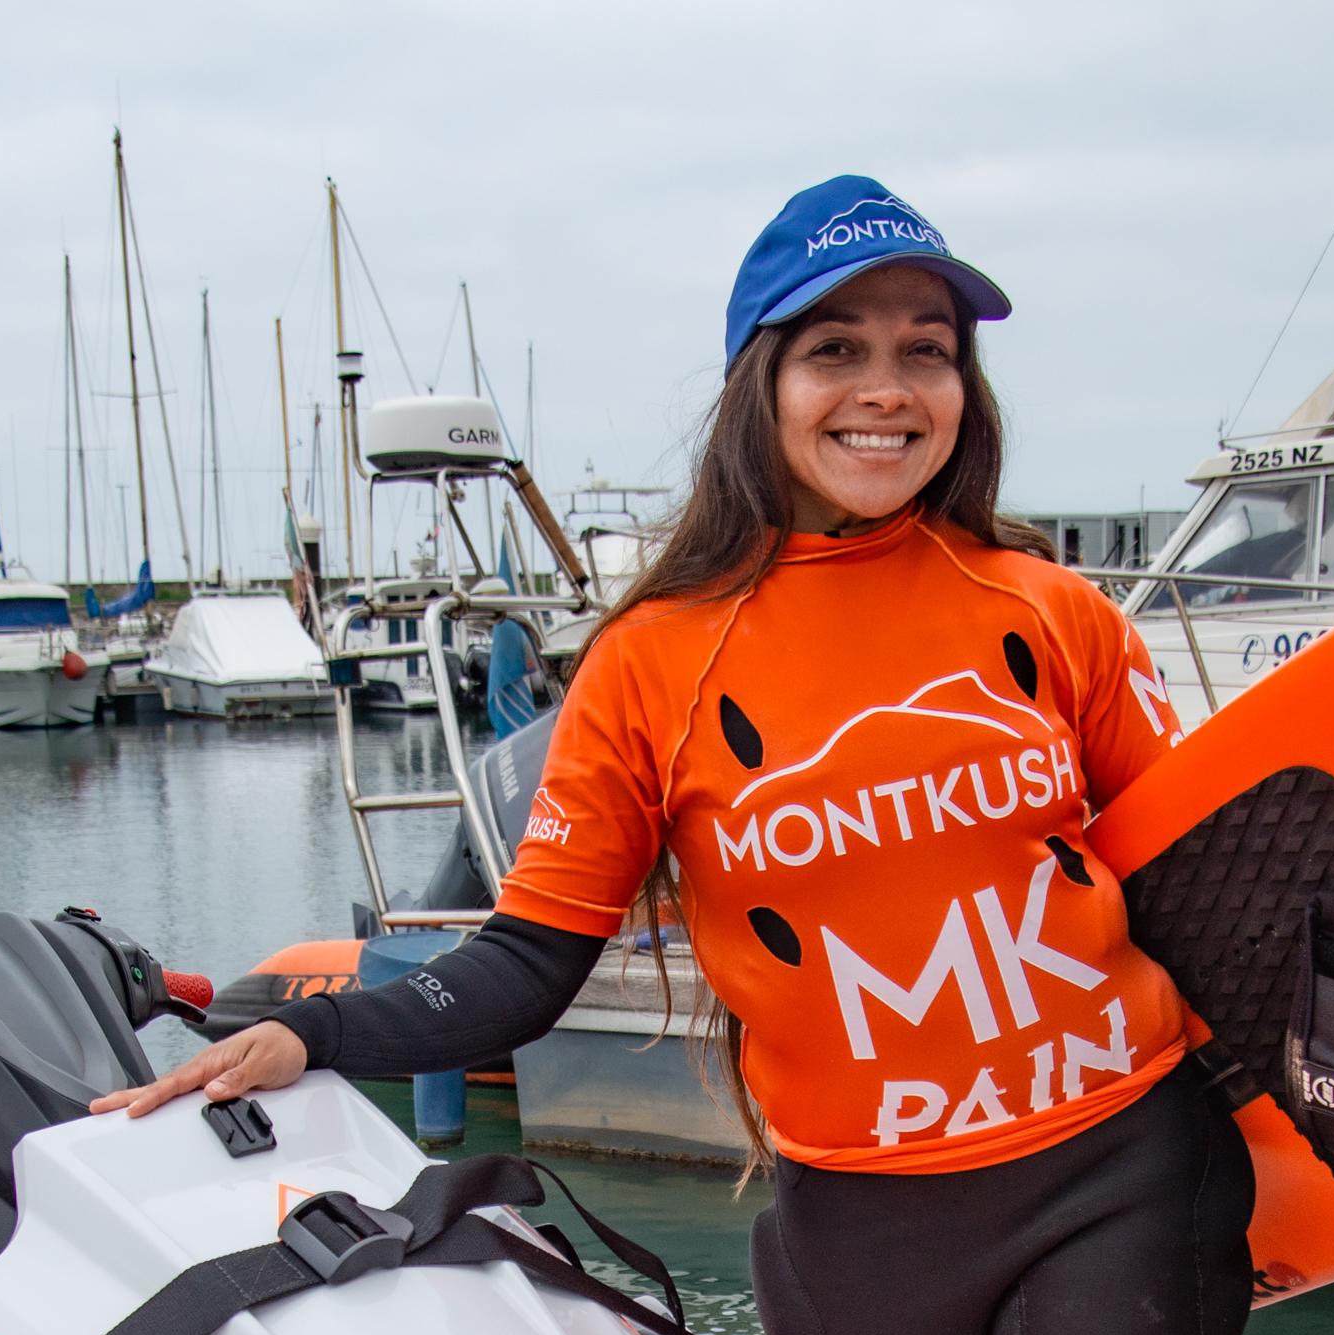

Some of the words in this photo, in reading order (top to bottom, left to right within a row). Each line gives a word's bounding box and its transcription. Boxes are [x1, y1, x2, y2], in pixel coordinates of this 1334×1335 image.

[1230, 450, 1284, 472] 2525
[1291, 445, 1324, 465] NZ
[713, 740, 1077, 873] MONTKUSH
[820, 856, 1108, 1060] MK
[871, 997, 1137, 1147] PAIN
